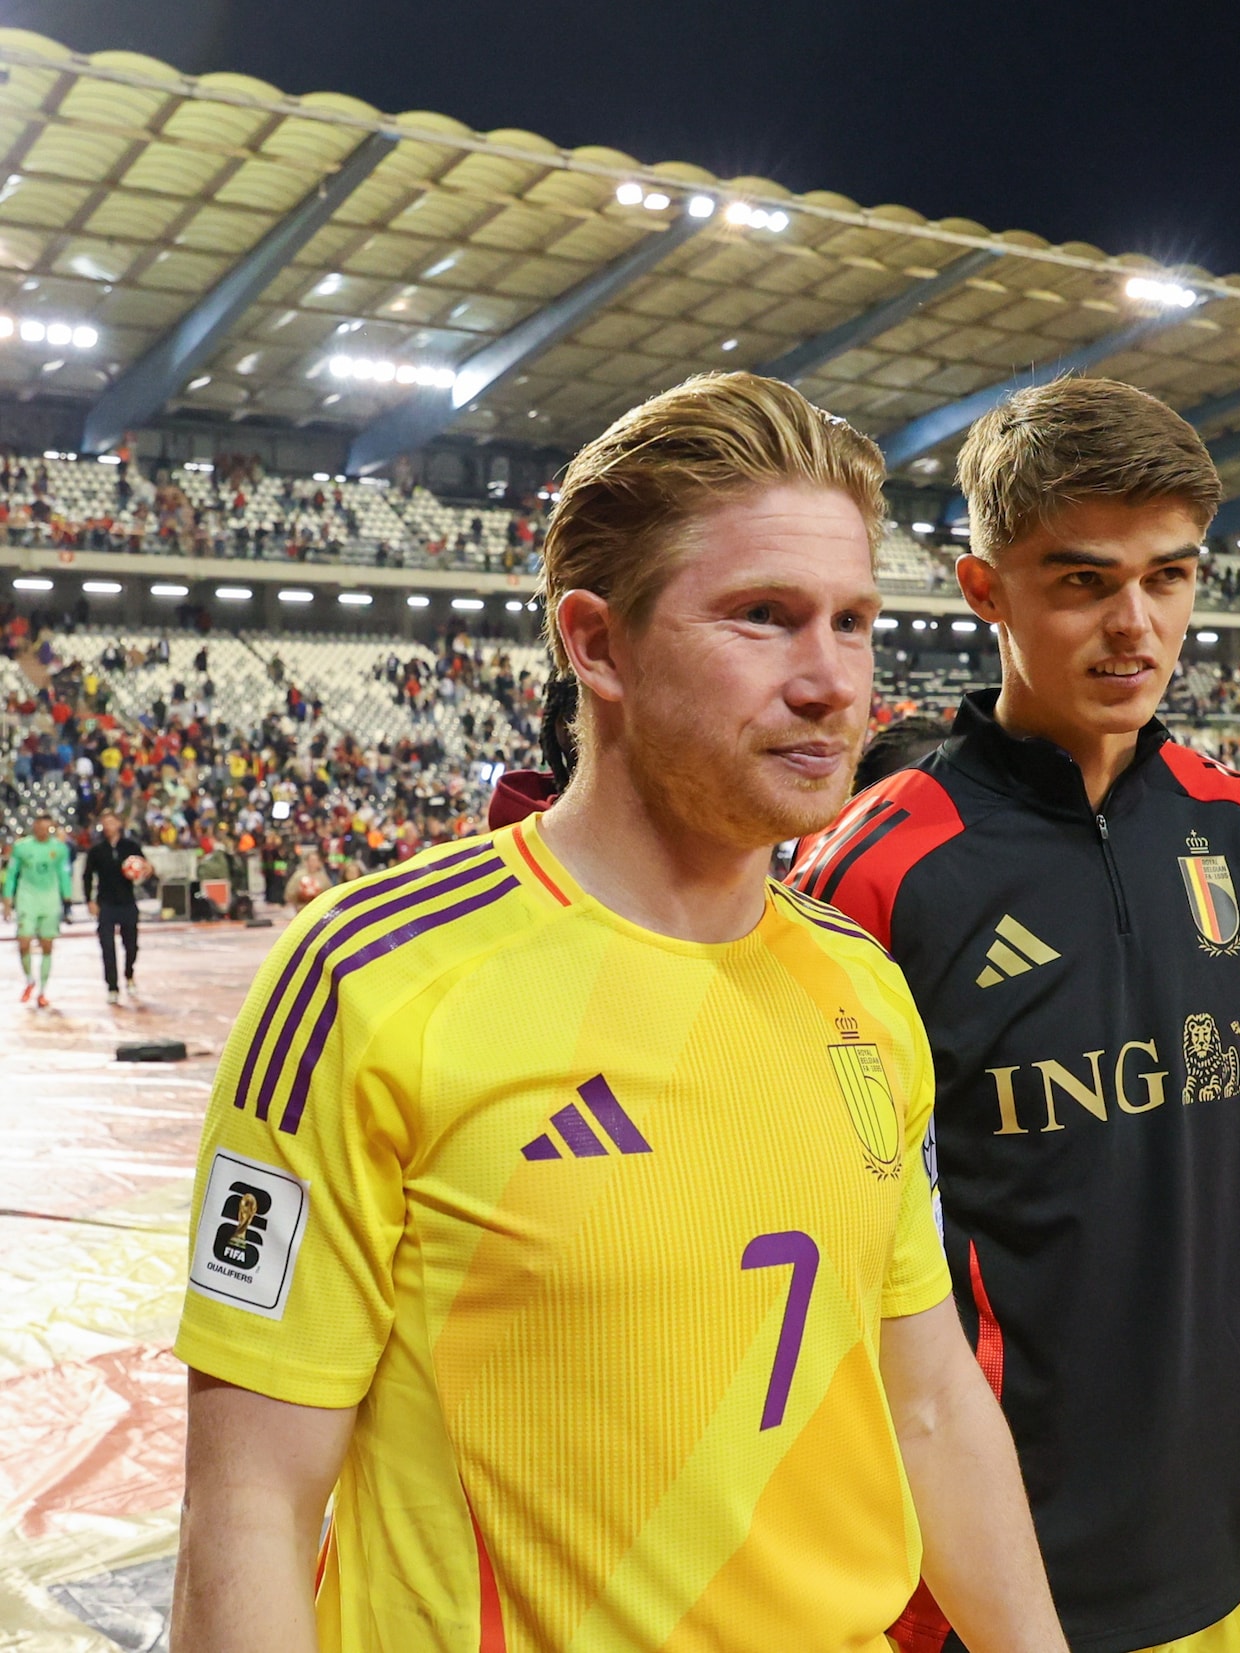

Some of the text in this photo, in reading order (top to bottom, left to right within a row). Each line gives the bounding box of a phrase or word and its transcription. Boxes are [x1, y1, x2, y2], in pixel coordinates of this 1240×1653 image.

[985, 1038, 1169, 1135] ING
[206, 1261, 253, 1284] QUALIFIERS
[223, 1247, 246, 1263] FIFA
[741, 1230, 820, 1432] 7
